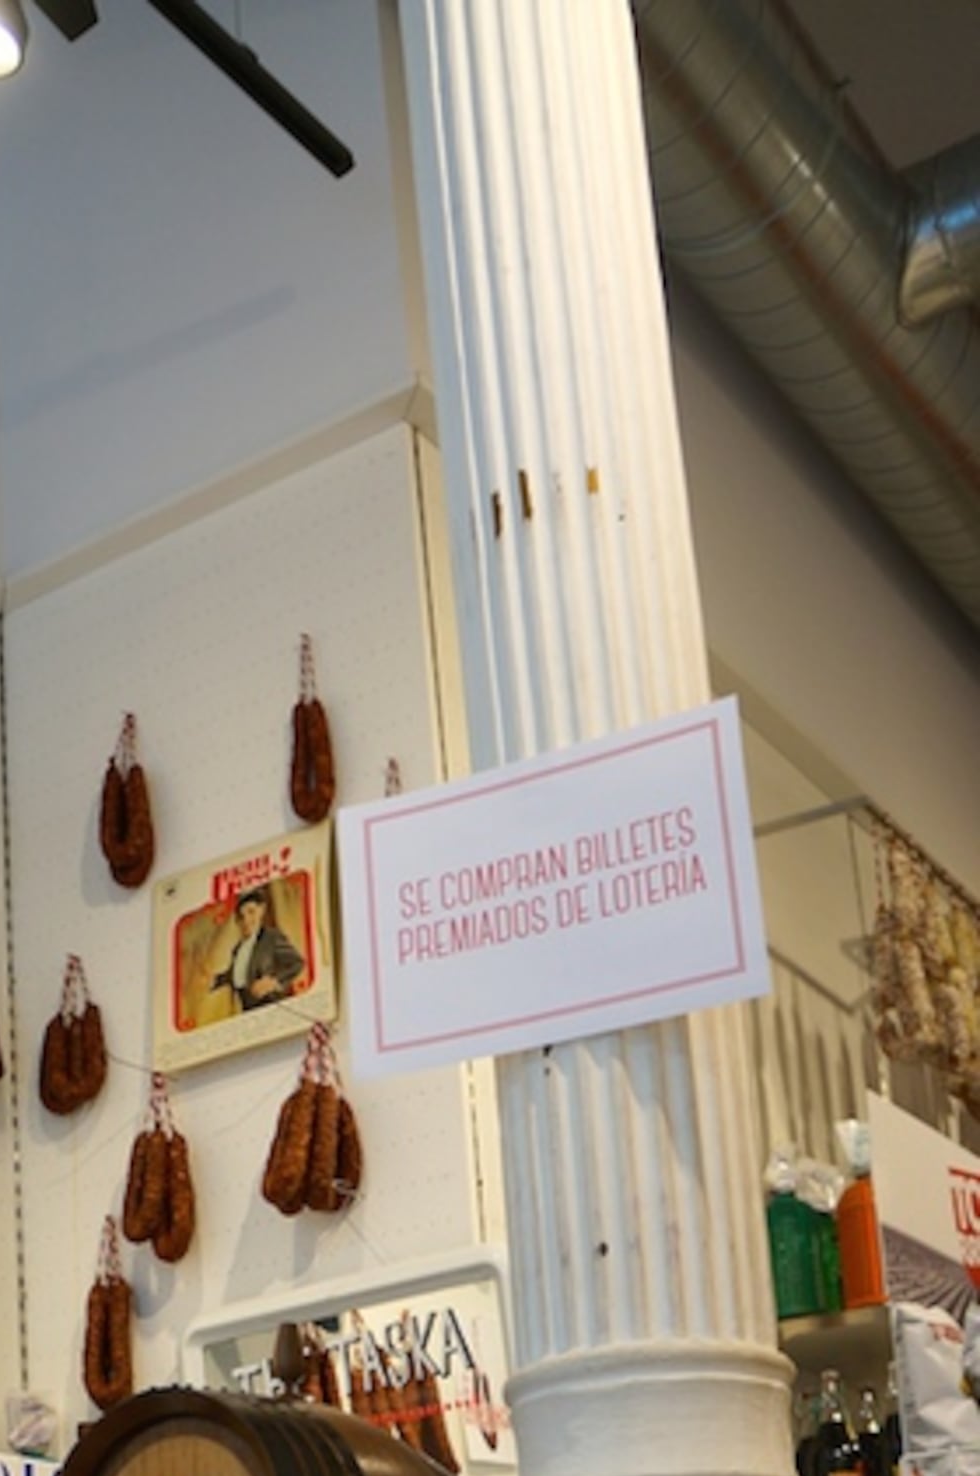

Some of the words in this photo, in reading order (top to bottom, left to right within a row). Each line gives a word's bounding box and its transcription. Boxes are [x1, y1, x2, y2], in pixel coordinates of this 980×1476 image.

[398, 877, 431, 920] SE
[439, 844, 568, 911] COMPRAN
[575, 807, 696, 872] BILLETES
[398, 895, 548, 965] PREMIADOS
[557, 884, 591, 928] DE
[598, 852, 707, 918] LOTERÍA
[325, 1307, 475, 1397] TASKA
